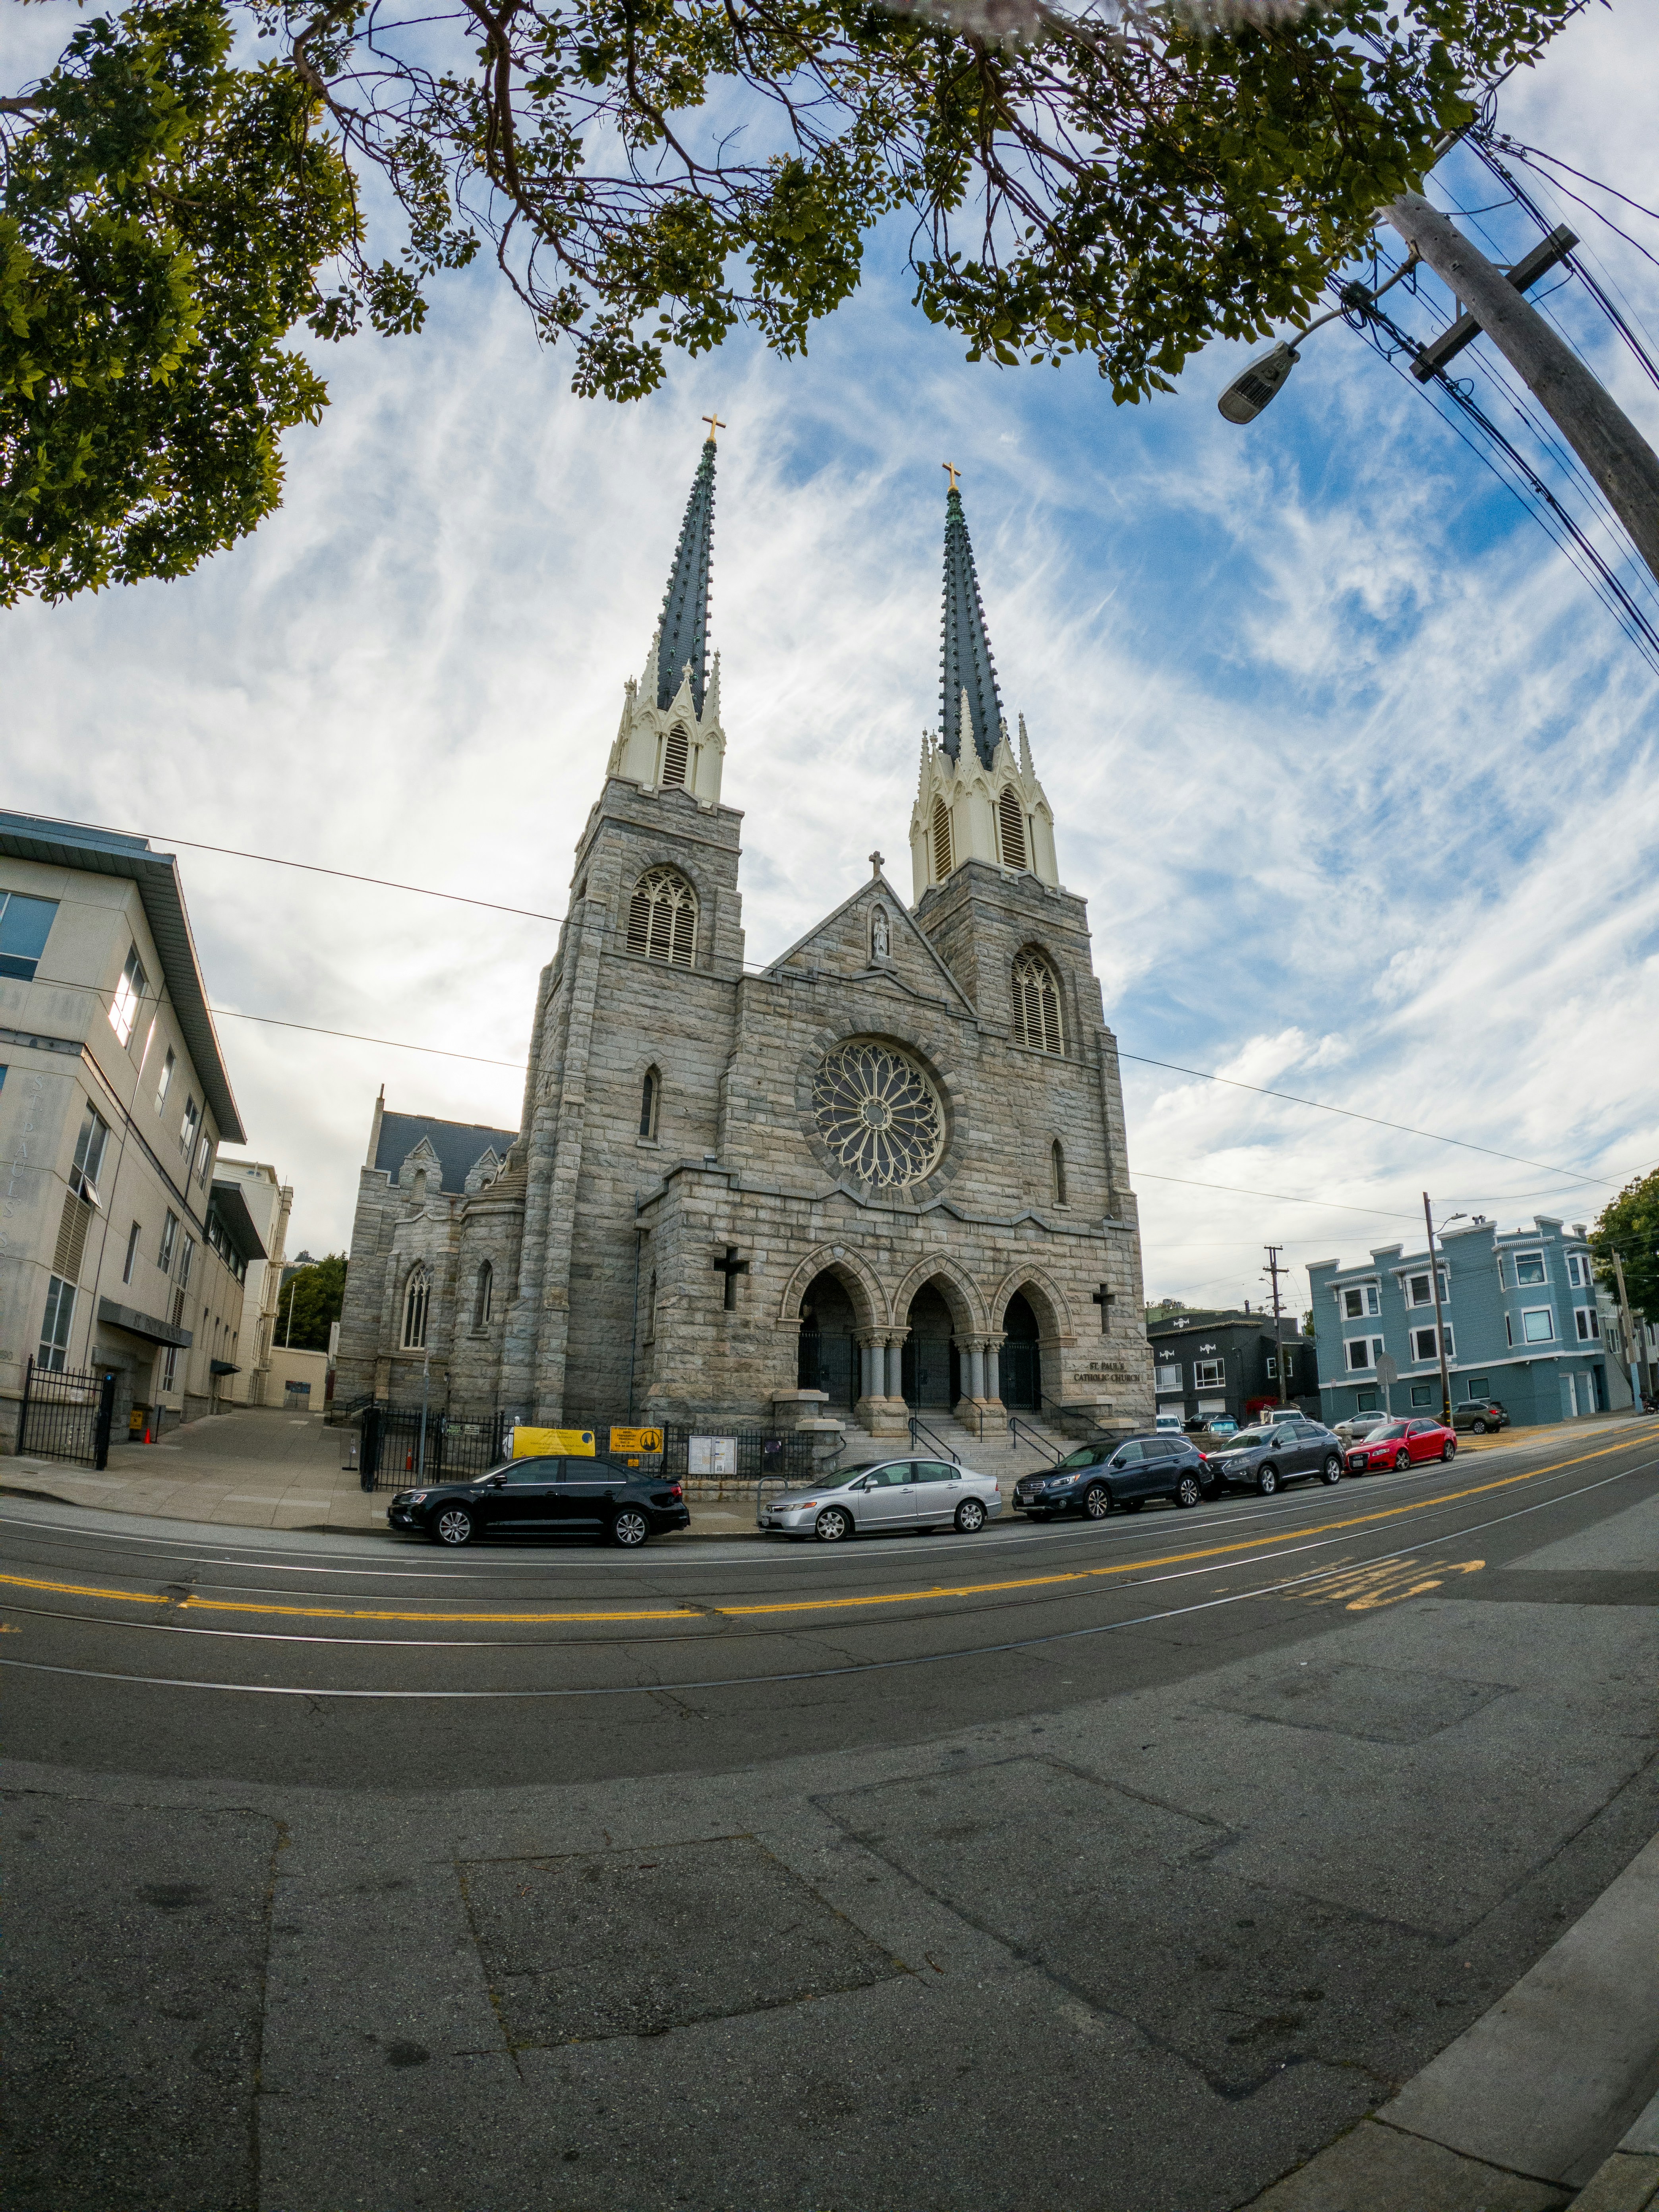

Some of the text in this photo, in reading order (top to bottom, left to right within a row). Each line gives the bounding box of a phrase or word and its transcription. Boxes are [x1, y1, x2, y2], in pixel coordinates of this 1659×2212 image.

[3, 1075, 44, 1218] ST. PAUL'S
[1111, 1373, 1140, 1382] CHURCH
